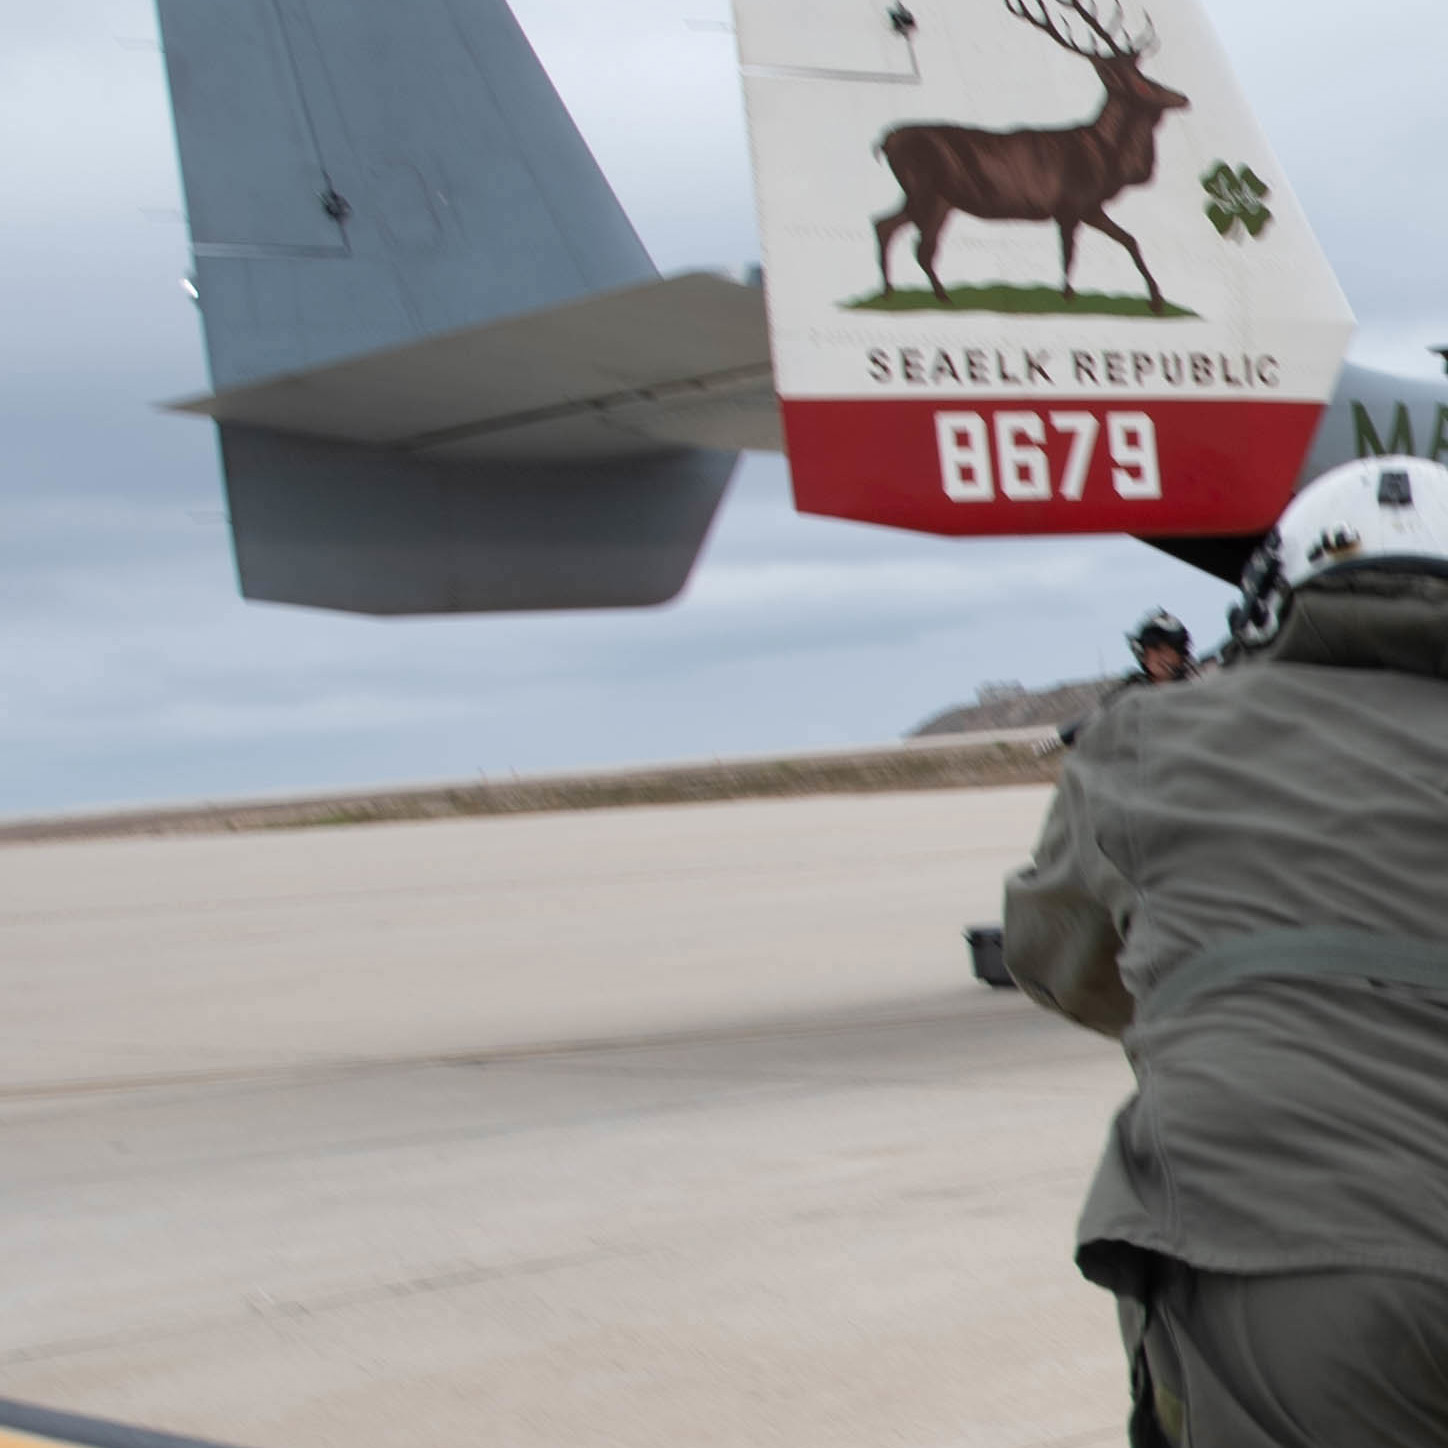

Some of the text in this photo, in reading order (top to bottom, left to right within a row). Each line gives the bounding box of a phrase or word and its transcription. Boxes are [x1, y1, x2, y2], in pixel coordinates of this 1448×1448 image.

[866, 346, 1281, 389] SEAELK REPUBLIC
[933, 409, 1163, 503] 8679
